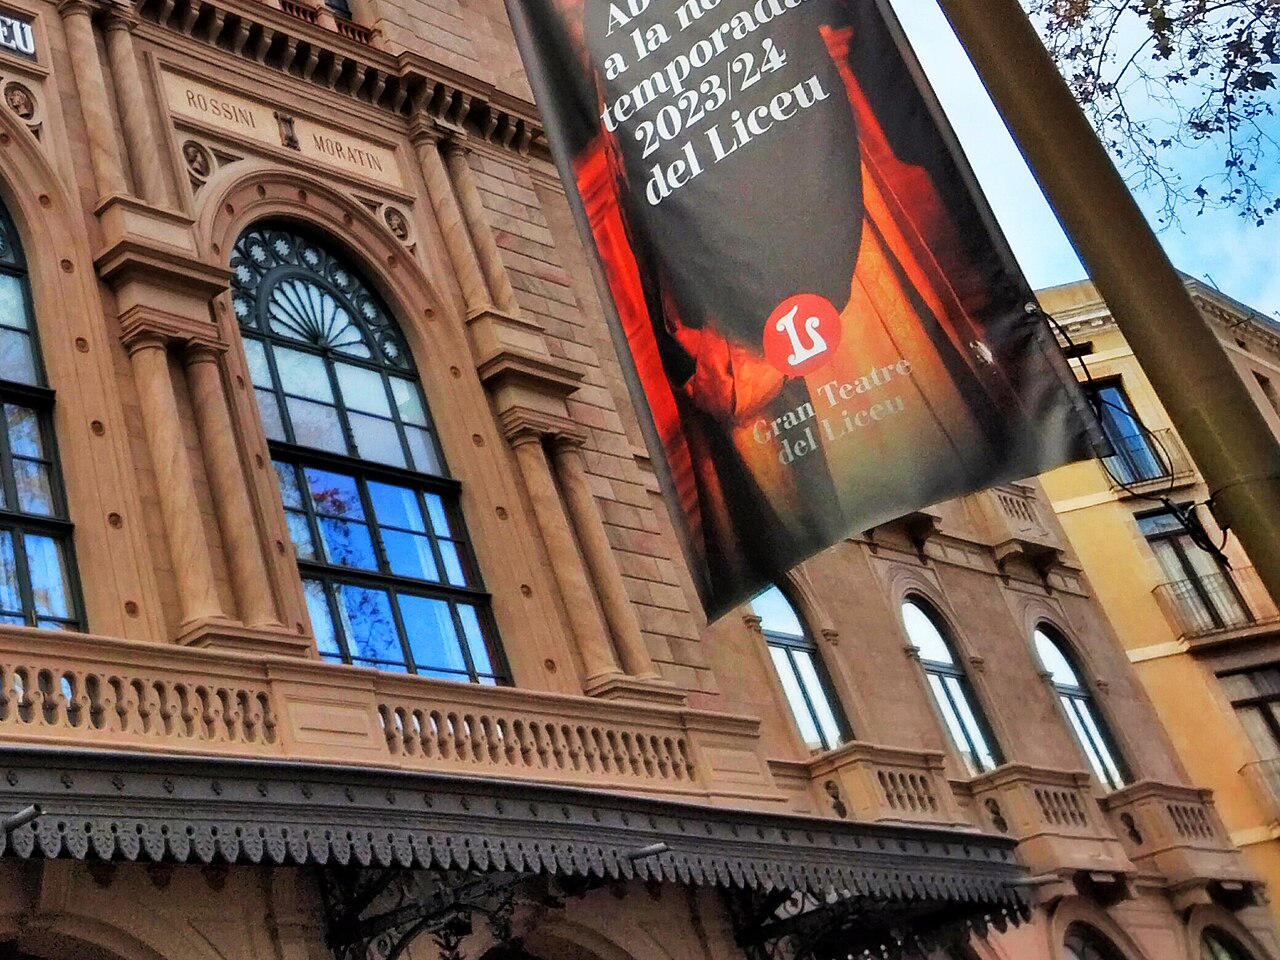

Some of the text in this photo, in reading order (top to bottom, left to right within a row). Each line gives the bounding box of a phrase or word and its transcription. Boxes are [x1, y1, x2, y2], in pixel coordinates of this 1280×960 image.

[605, 52, 629, 81] a
[629, 23, 671, 62] la
[186, 89, 256, 129] ROSSINI
[634, 37, 788, 160] 2023/24
[312, 133, 383, 172] MORATIN
[646, 74, 831, 207] del Liceu
[752, 359, 913, 445] Gran Teatre
[778, 395, 905, 465] del Liceu
